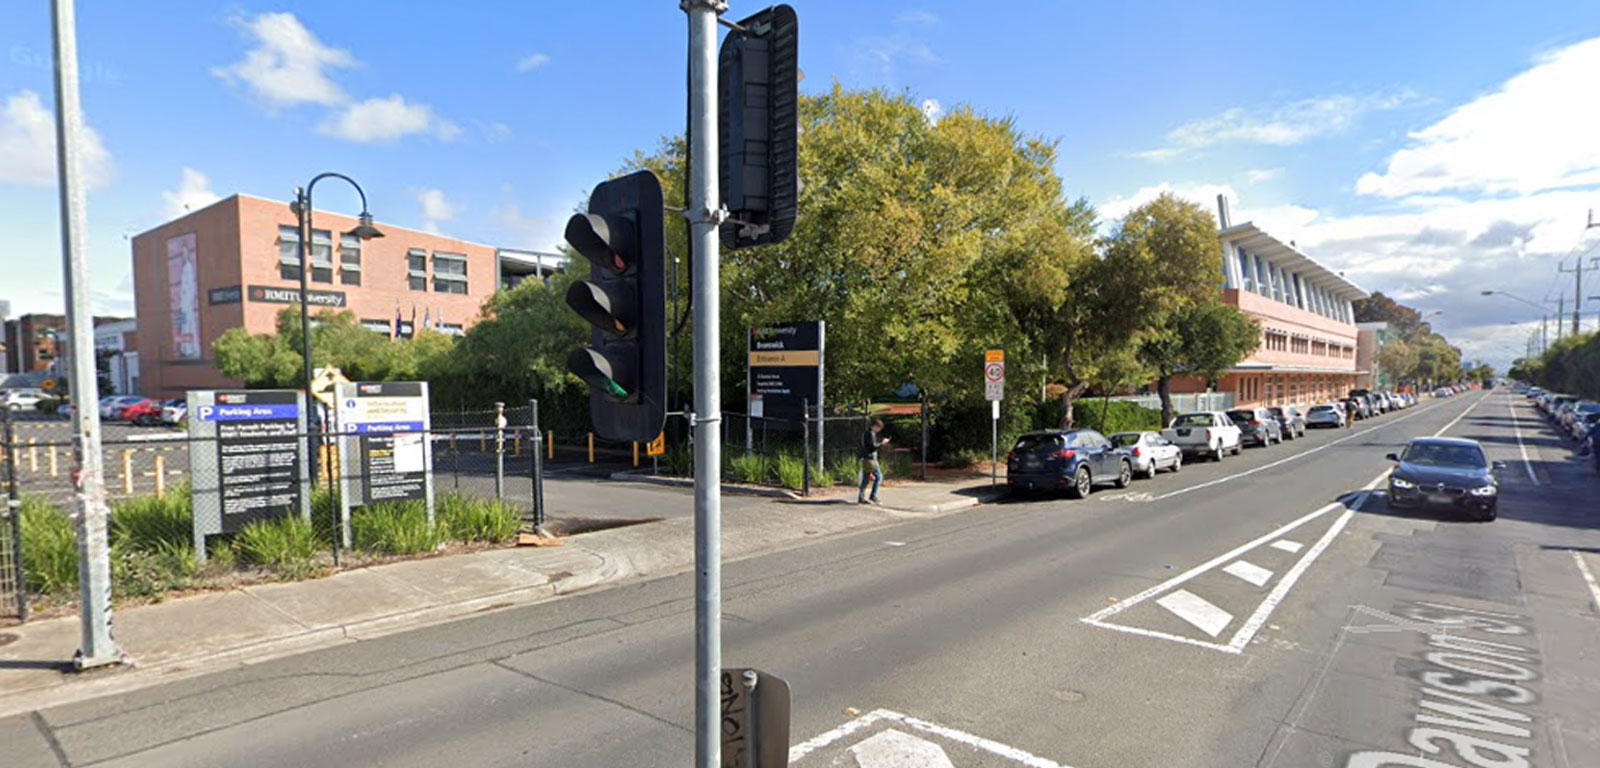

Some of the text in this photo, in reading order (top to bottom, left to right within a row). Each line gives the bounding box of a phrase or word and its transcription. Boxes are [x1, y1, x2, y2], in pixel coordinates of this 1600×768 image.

[264, 289, 294, 301] RMIT
[200, 406, 213, 420] P
[220, 407, 272, 417] Parking Area
[347, 424, 358, 432] P
